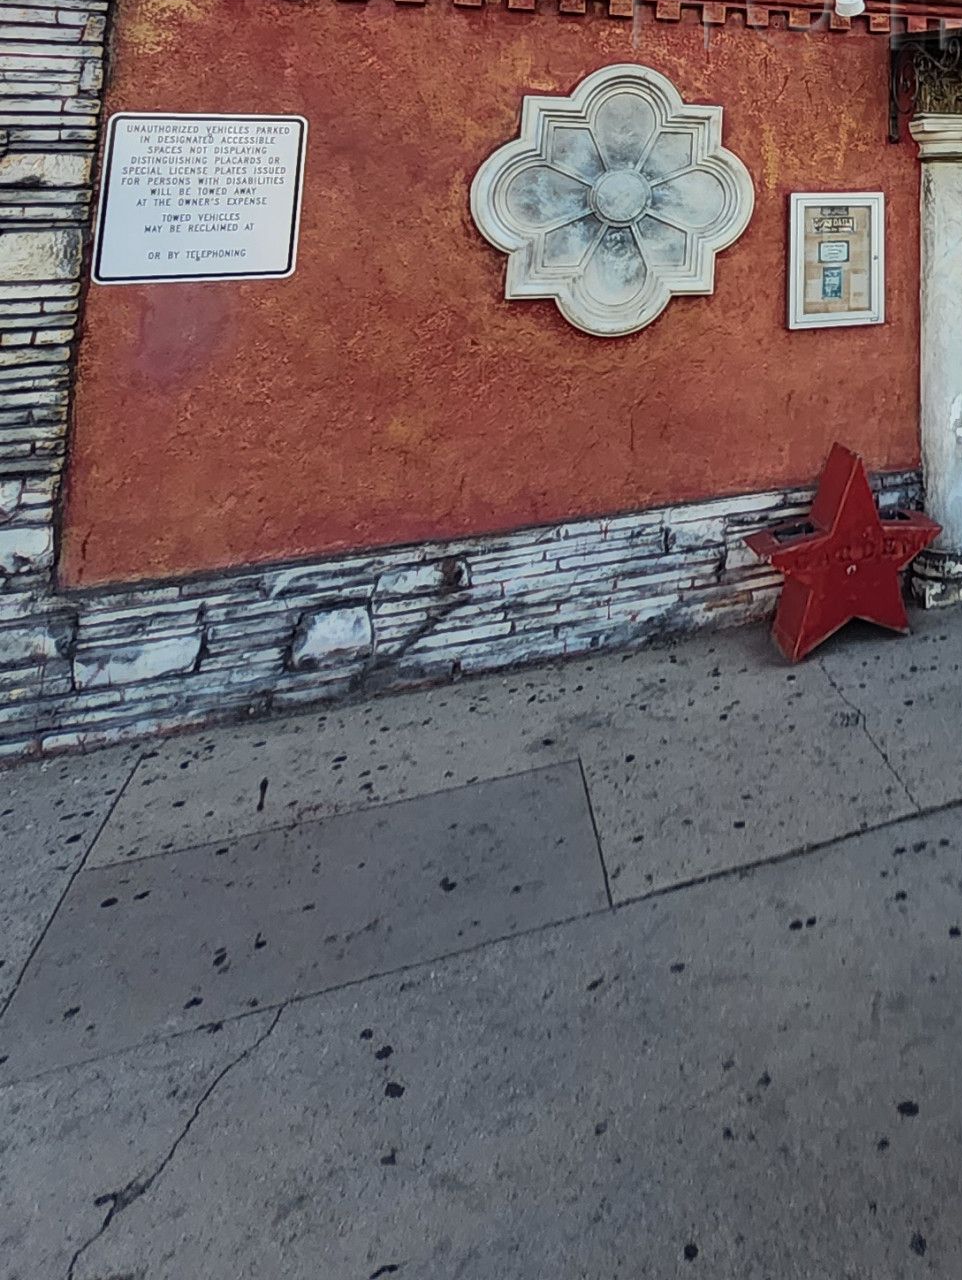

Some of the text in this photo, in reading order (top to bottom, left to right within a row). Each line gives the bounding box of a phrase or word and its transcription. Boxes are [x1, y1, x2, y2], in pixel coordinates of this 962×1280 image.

[126, 124, 290, 135] UNAUTHORIZED VEHICLES PARKED
[140, 135, 276, 145] IN DESIGNATED ACCESSIBLE
[147, 146, 268, 154] SPACES NOT DISPLAYING
[130, 156, 280, 165] DISTINGUISHING PLACARDS OR
[122, 166, 287, 175] SPECIAL LICENSE PLATES ISSUED
[121, 176, 285, 186] FOR PERSONS WITH DISABILITIES
[150, 187, 257, 196] WILL BE TOWED AWAY
[136, 197, 267, 207] AT THE OWNER'S EXPENSE
[162, 212, 240, 222] TOWED VEHICLES
[144, 222, 254, 233] MAY BE RECLAIMED AT
[147, 249, 247, 260] OR BY TELEPHONING
